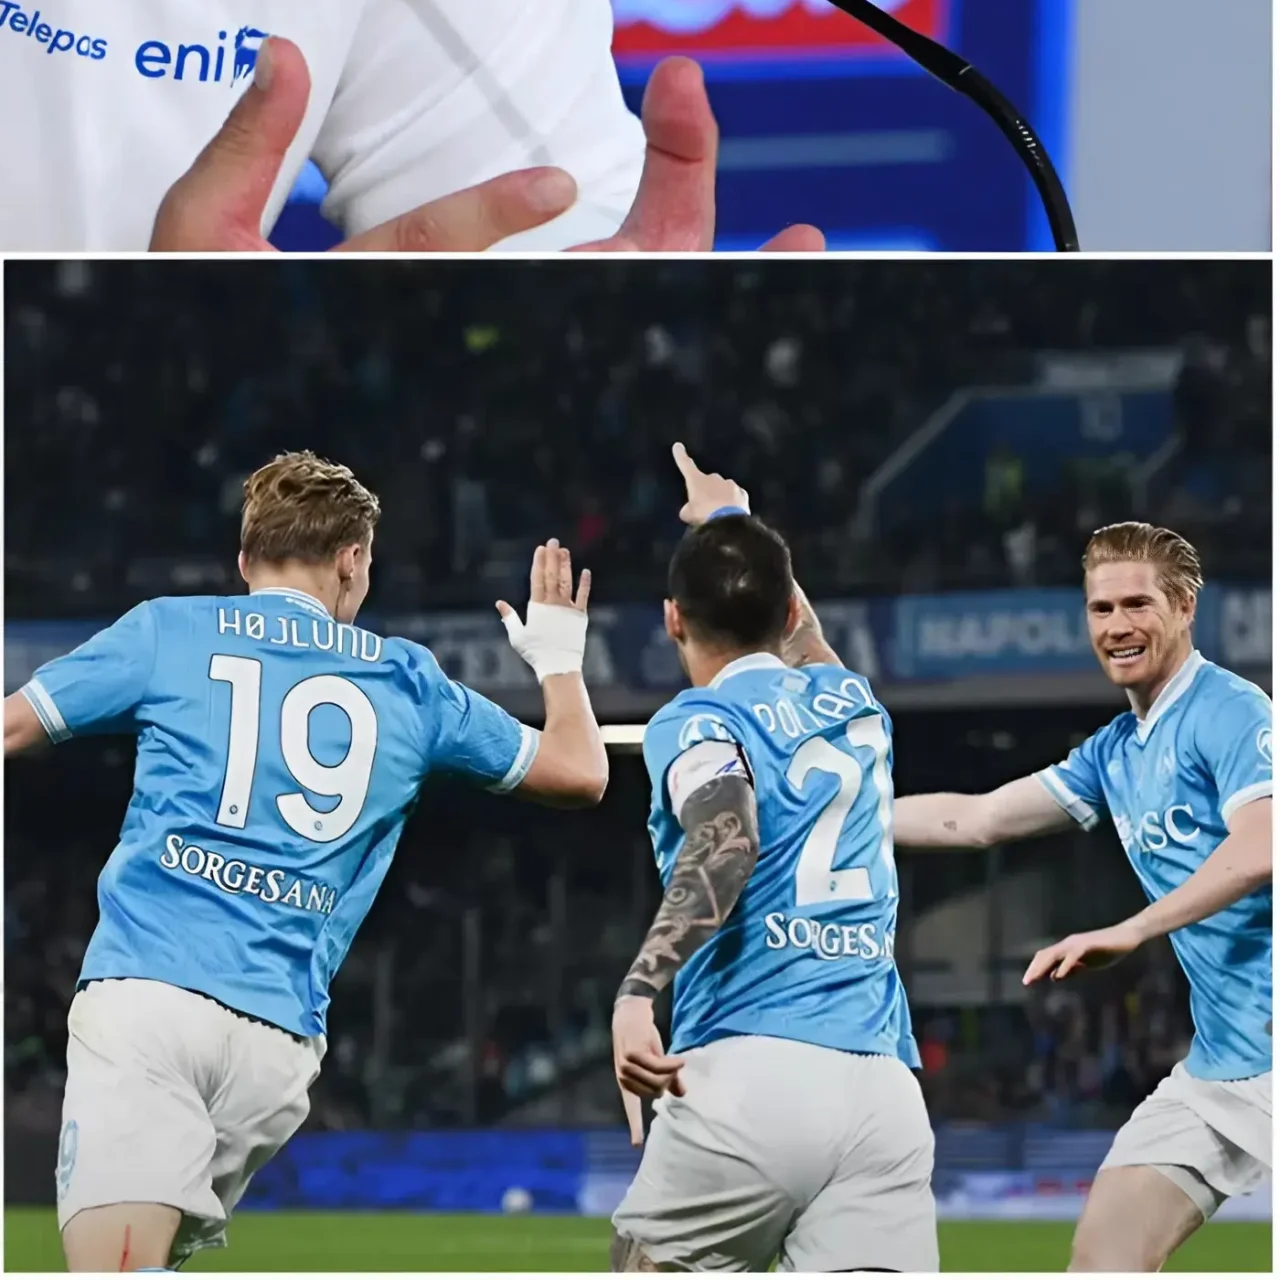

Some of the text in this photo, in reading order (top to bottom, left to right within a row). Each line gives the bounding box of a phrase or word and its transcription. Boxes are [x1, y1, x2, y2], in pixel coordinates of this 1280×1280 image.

[135, 30, 226, 82] eni
[218, 607, 384, 663] HØJLUND
[208, 652, 378, 844] 19
